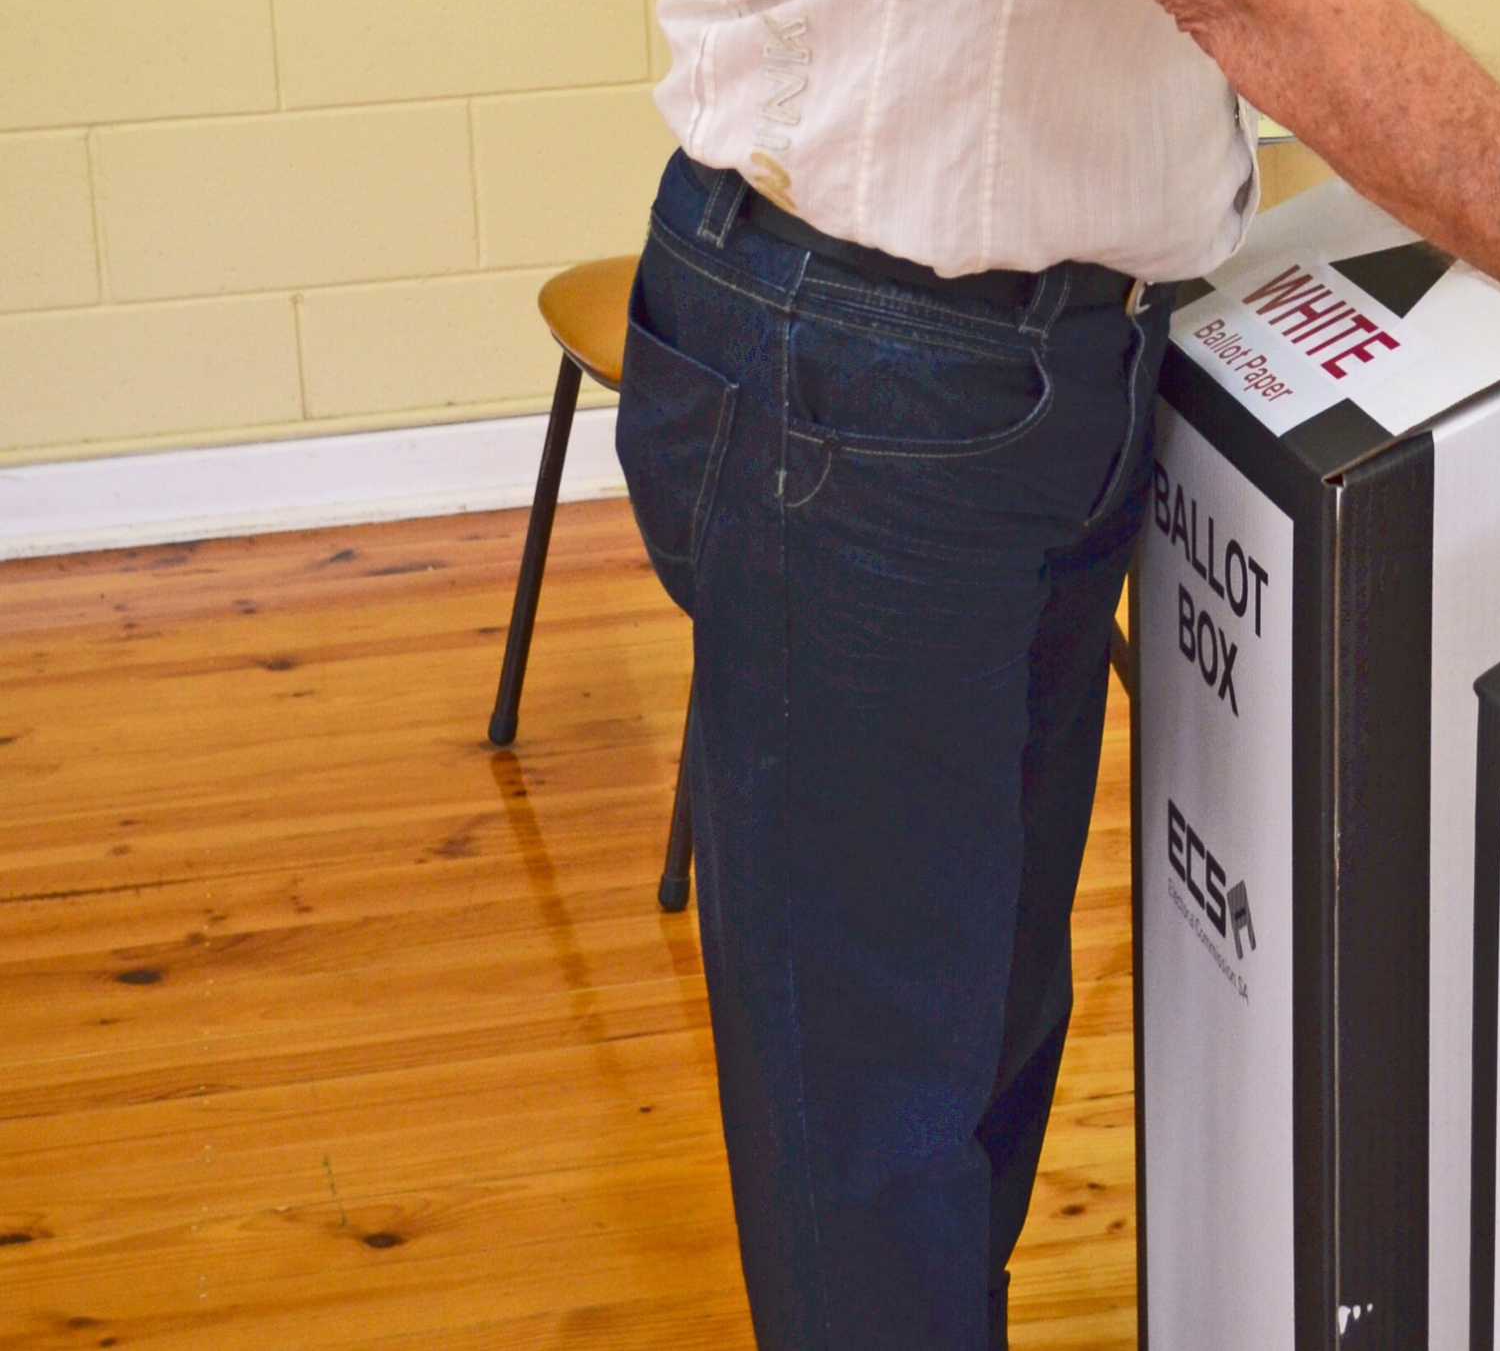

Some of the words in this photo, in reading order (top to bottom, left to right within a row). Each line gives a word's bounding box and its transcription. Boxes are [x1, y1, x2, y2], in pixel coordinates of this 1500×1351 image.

[1193, 318, 1248, 366] Ballot
[1234, 354, 1294, 403] Paper
[1242, 264, 1401, 380] WHITE
[1154, 458, 1269, 638] BALLOT
[1179, 582, 1239, 718] BOX
